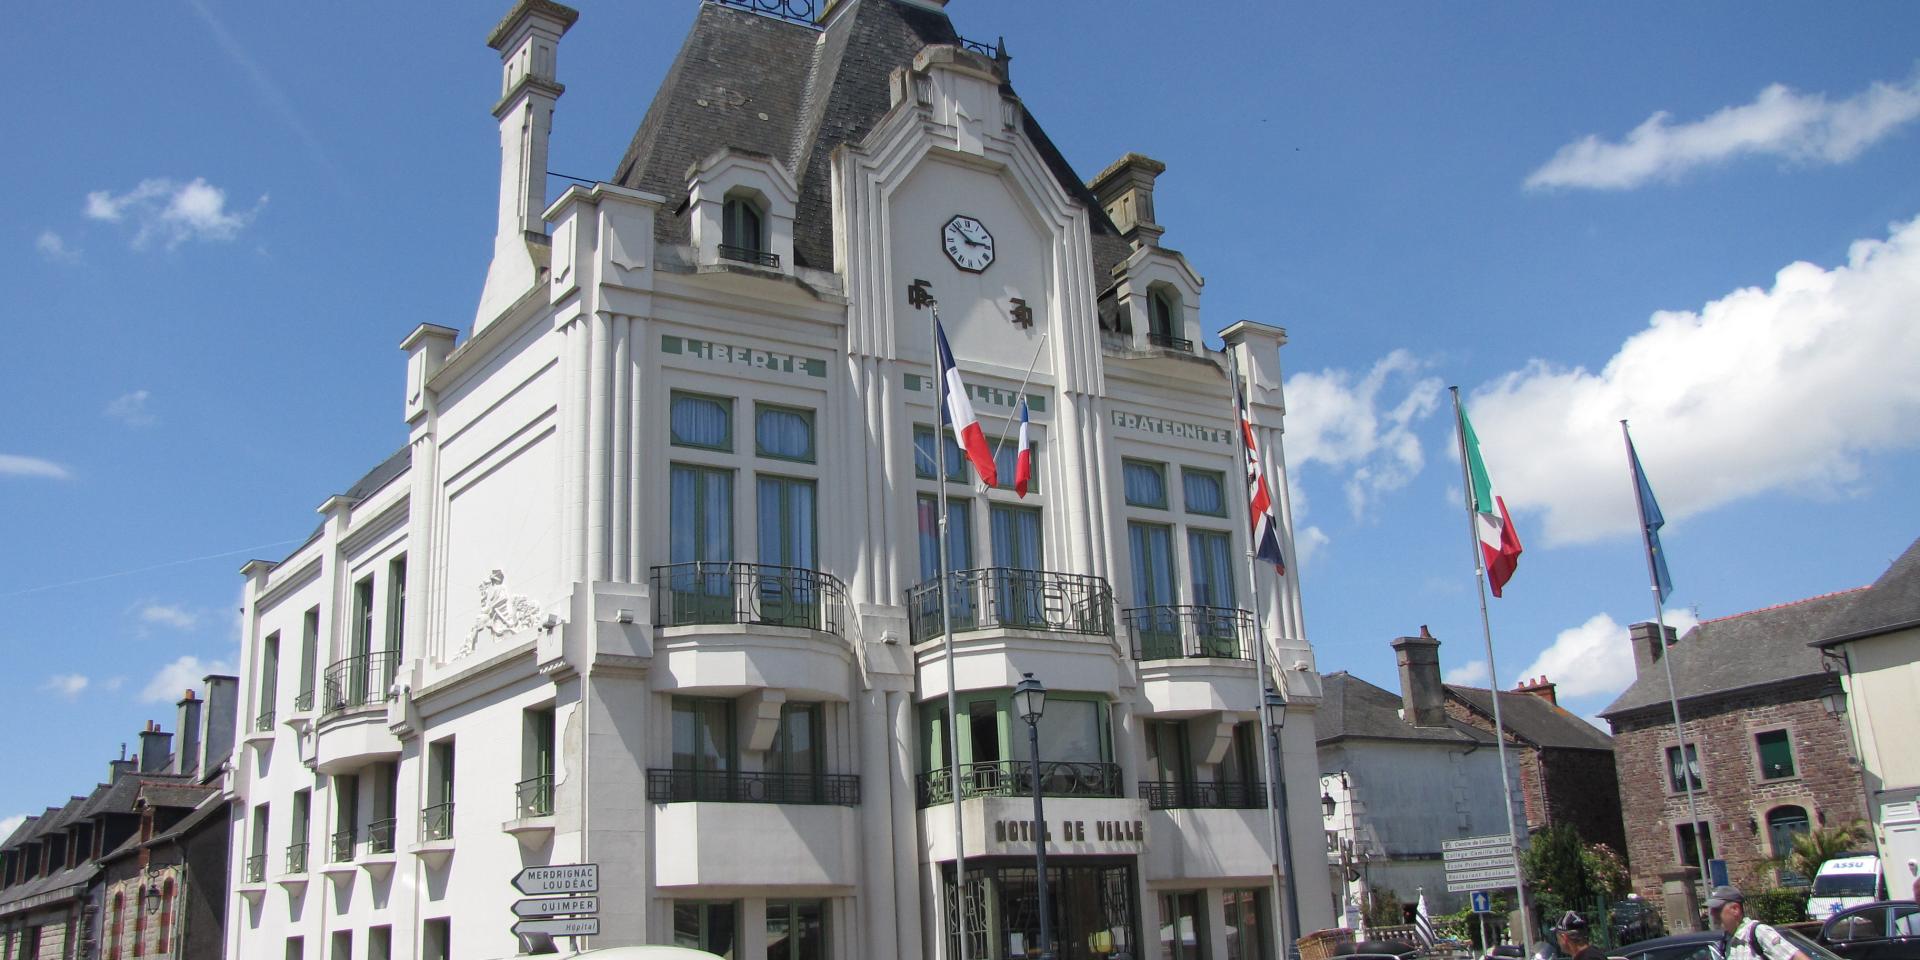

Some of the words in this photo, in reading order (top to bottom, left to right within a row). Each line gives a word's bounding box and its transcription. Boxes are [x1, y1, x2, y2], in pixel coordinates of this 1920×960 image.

[1063, 820, 1085, 842] DE
[1832, 861, 1864, 869] ASSU
[528, 868, 593, 880] MERDRIGNAC
[543, 878, 593, 890] LOUDÉAC
[541, 900, 593, 912] QUIMPER
[566, 922, 596, 932] Hôpital
